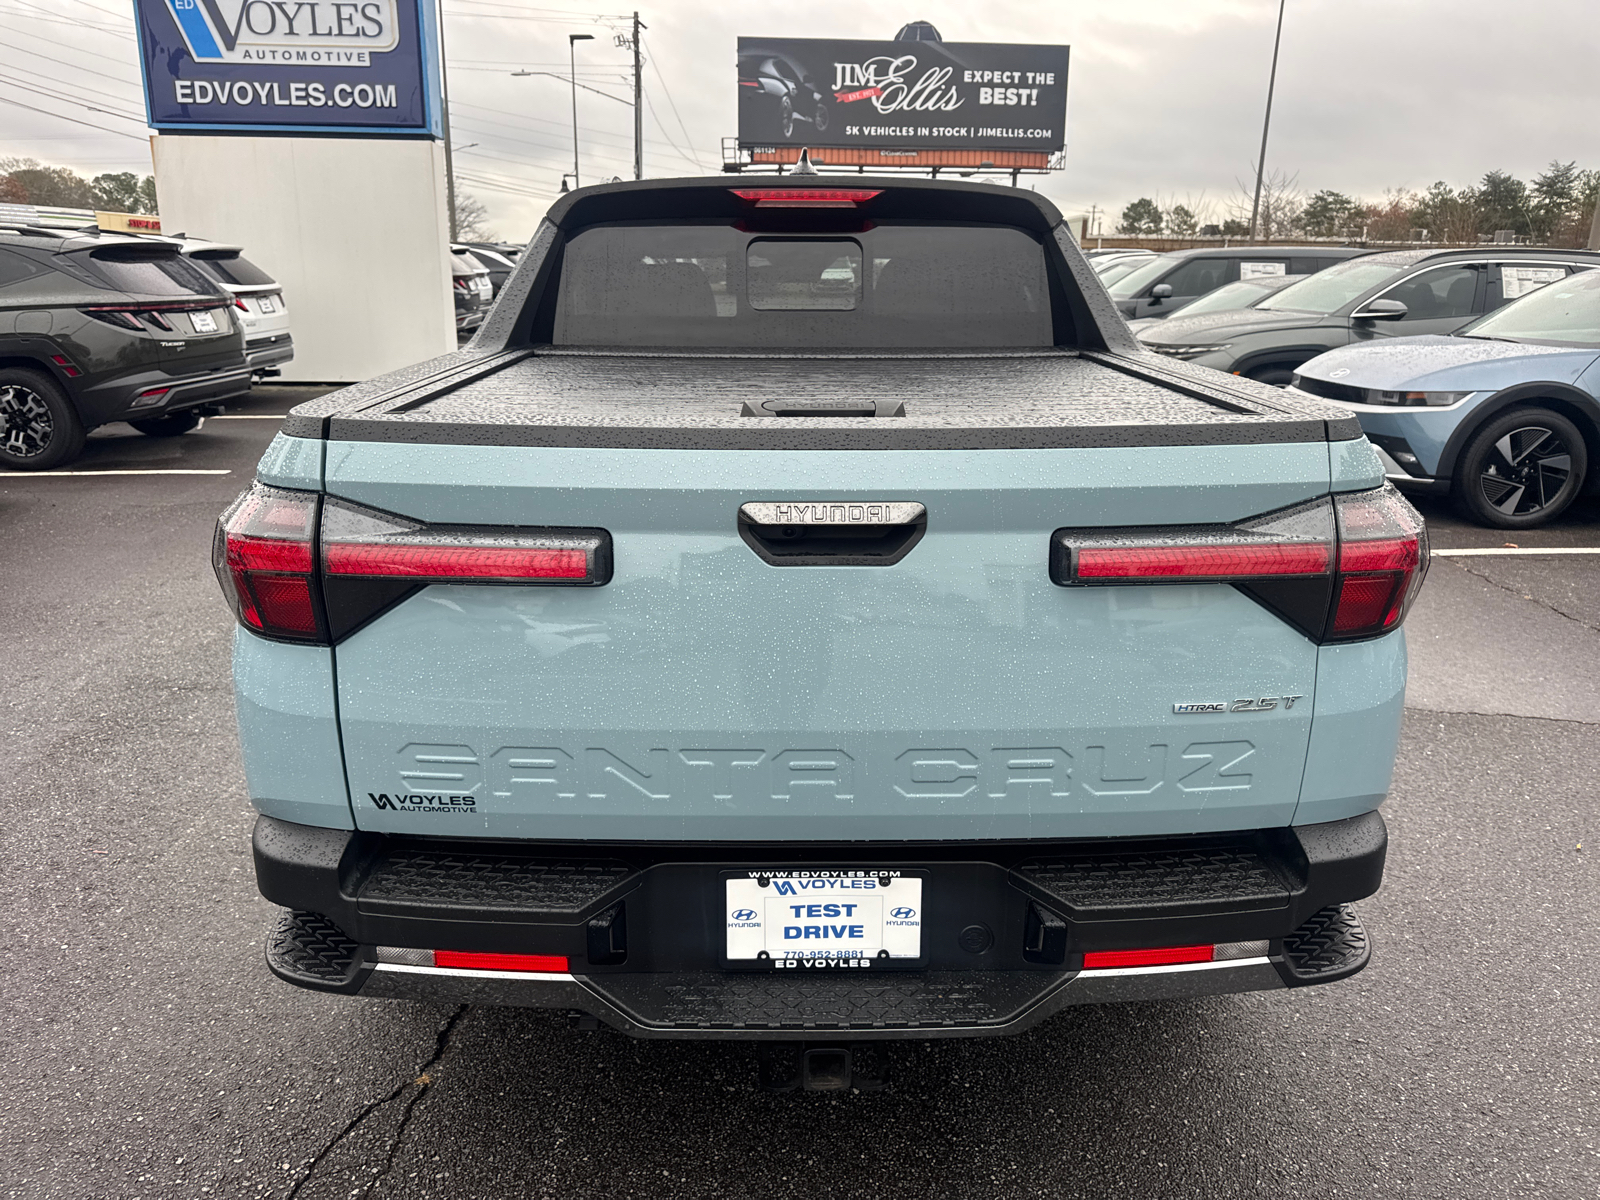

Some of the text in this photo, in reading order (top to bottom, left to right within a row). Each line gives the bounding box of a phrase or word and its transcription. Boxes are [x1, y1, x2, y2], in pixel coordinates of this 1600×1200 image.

[205, 0, 384, 51] VOYLES
[242, 49, 367, 63] AUTOMOTIVE
[831, 55, 966, 114] JIM Ellis
[963, 70, 1056, 85] EXPECT THE
[174, 80, 398, 108] EDVOYLES.COM
[979, 87, 1038, 106] BEST!
[845, 126, 860, 136] 5K
[863, 126, 915, 136] VEHICLES
[917, 127, 930, 136] IN
[932, 127, 968, 137] STOCK
[977, 128, 1052, 138] JIMELLIS.COM
[785, 402, 866, 410] HYUNDAI
[775, 505, 891, 523] HYUNDAI
[1176, 703, 1226, 713] HTRAC
[397, 740, 1256, 799] SANTA CRUZ
[394, 794, 477, 806] VOYLES
[399, 805, 478, 813] AUTOMOTIVE
[798, 879, 877, 889] VOYLES
[789, 904, 858, 918] TEST
[784, 925, 864, 940] DRIVE
[783, 950, 864, 959] 770-952-8881
[774, 959, 871, 969] ED VOYLES
